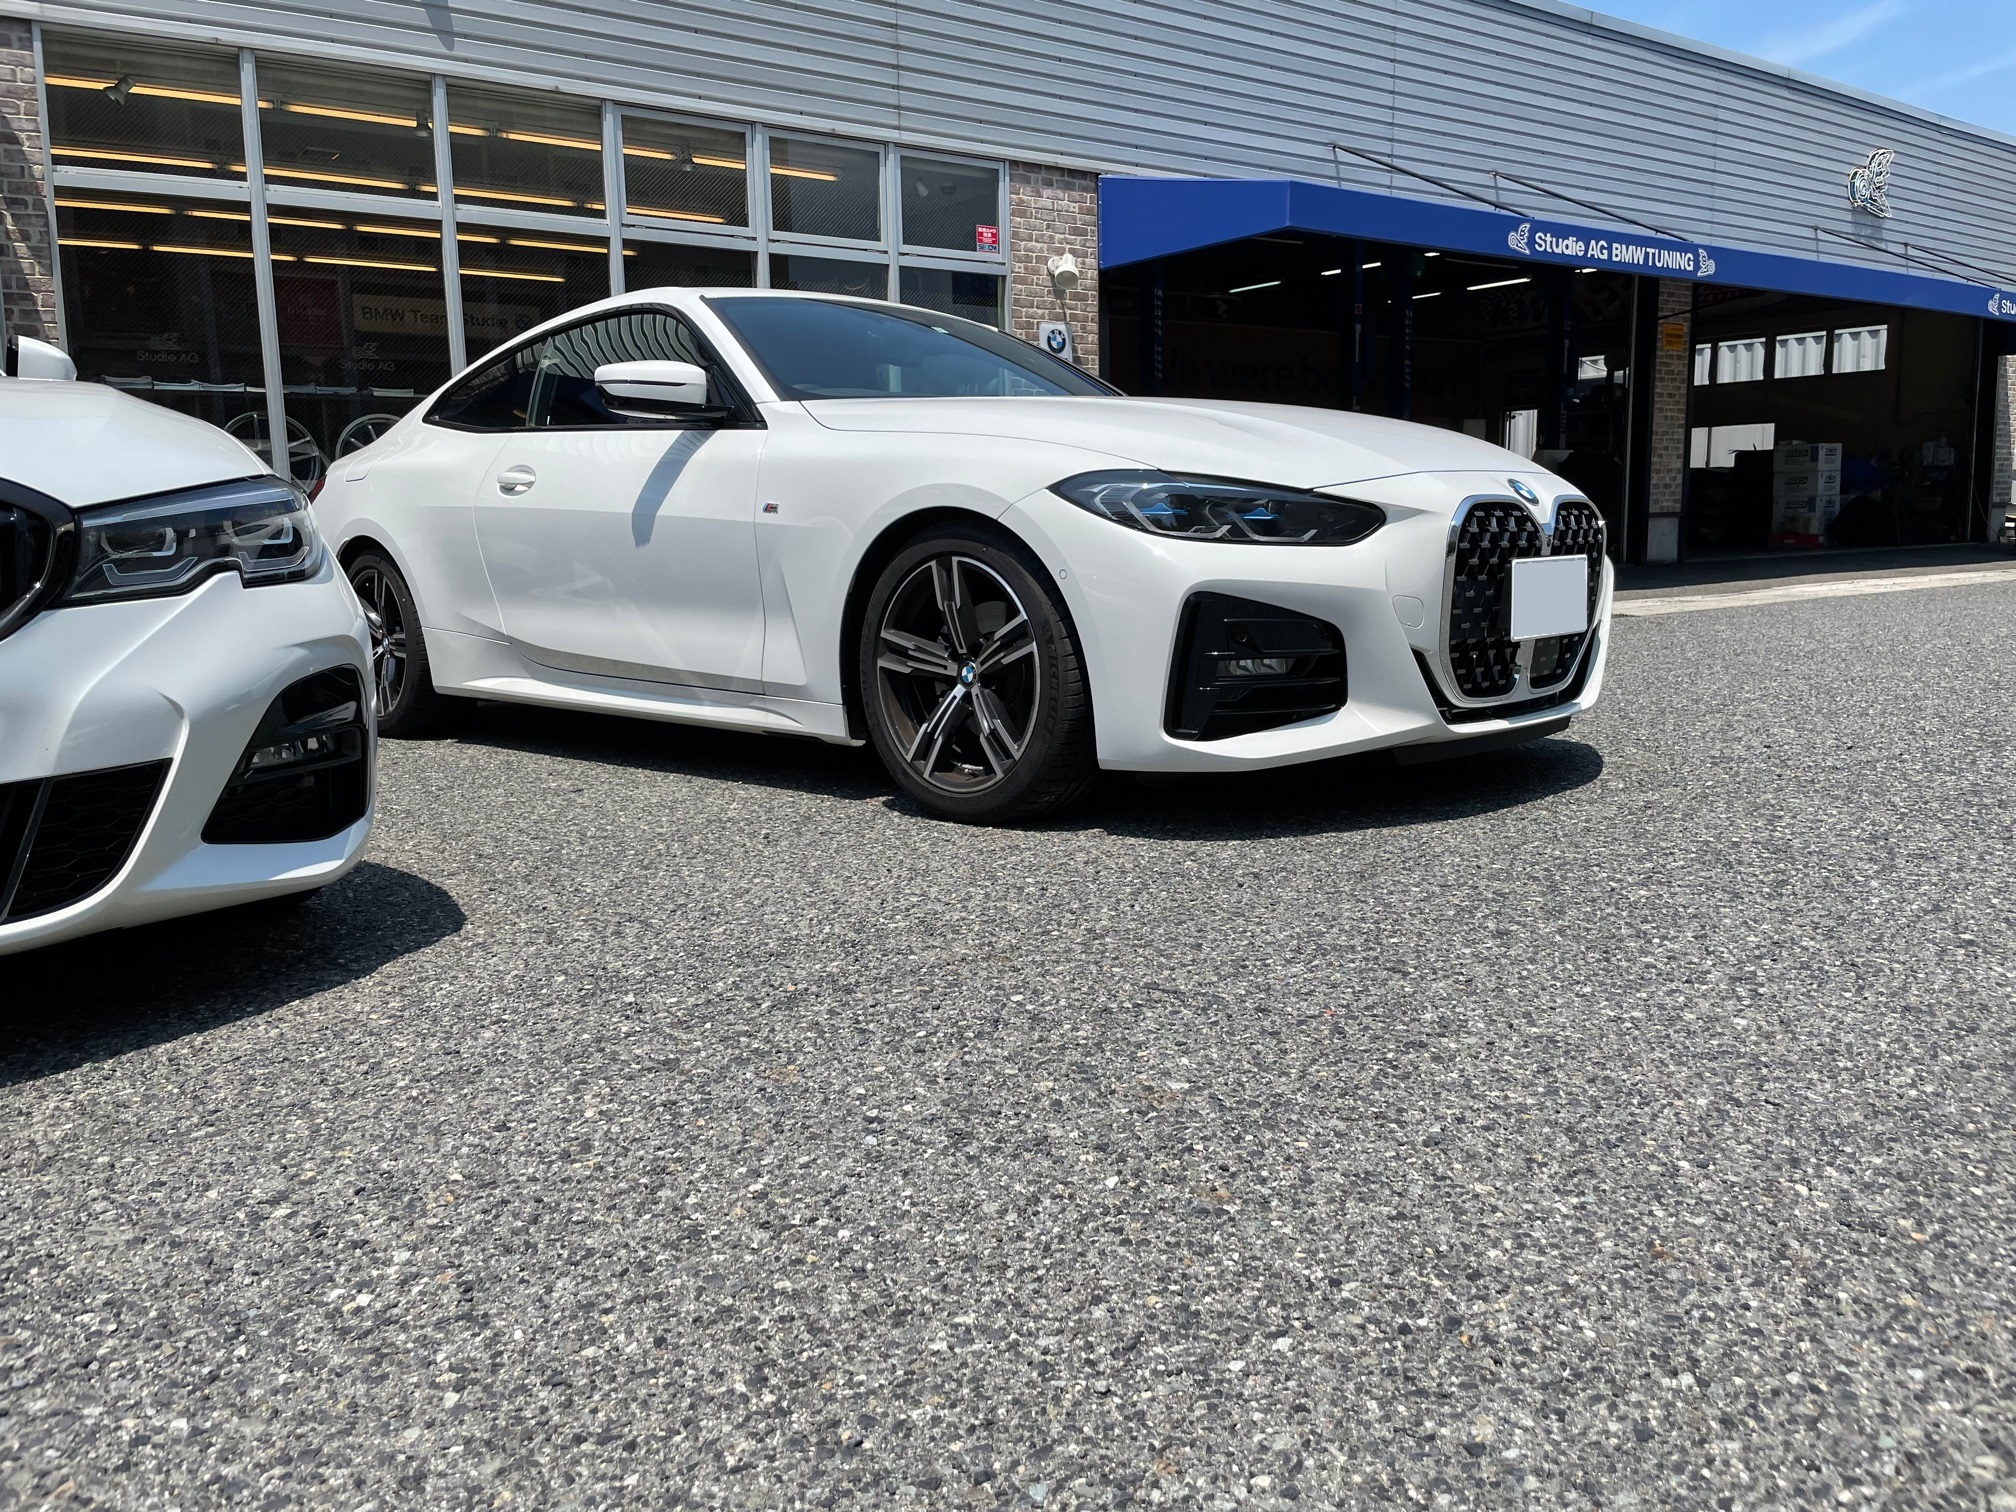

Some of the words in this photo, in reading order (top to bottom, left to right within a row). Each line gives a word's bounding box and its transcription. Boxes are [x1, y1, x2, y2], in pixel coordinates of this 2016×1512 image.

[1534, 232, 1585, 257] Studie
[1587, 240, 1608, 260] AG
[1612, 243, 1645, 266] BMW
[1645, 248, 1694, 271] TUNING
[360, 306, 405, 322] BMW
[2001, 299, 2016, 315] Stu
